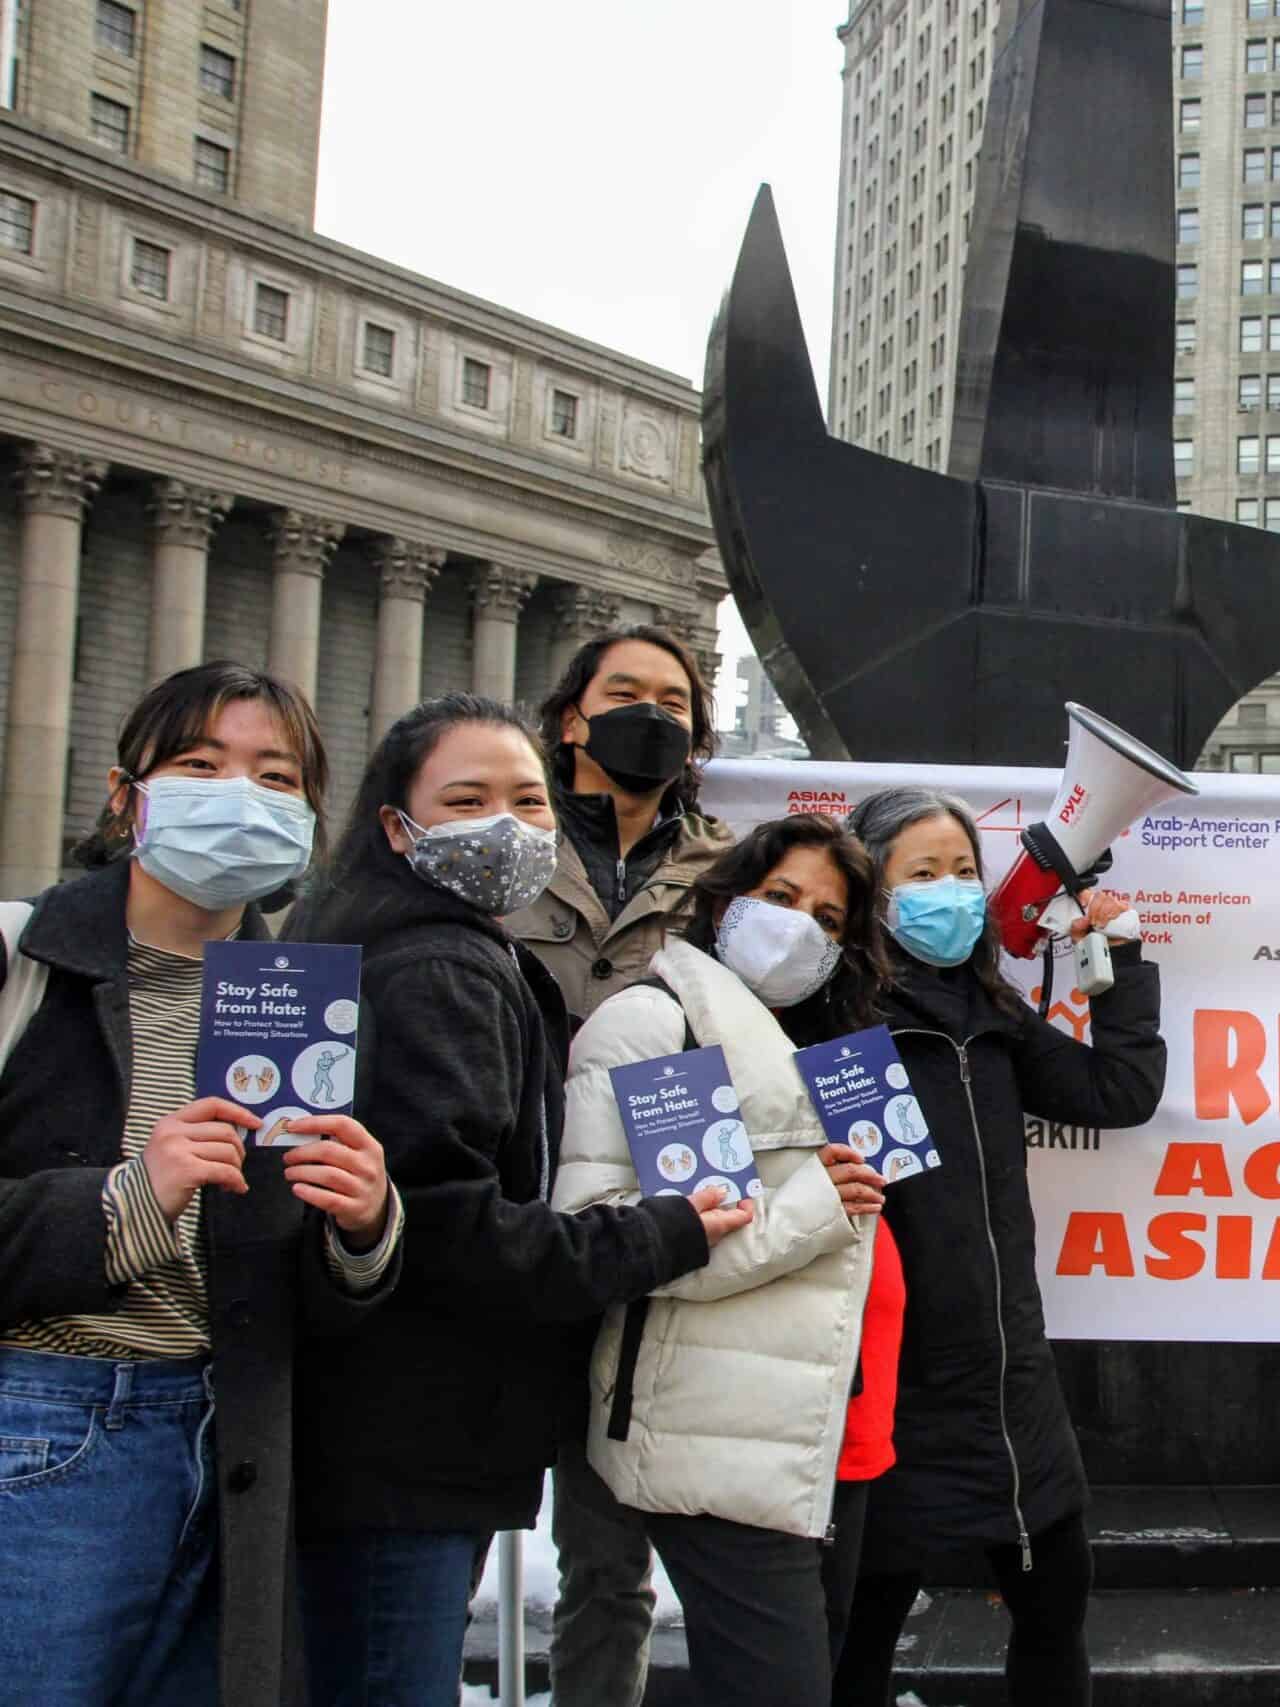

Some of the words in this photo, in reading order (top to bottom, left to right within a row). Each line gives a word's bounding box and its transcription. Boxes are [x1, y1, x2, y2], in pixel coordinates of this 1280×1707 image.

[787, 791, 846, 802] ASIAN
[1060, 783, 1085, 823] PYLE
[1142, 817, 1270, 834] Arab-American
[1142, 832, 1208, 851] Support
[1213, 835, 1270, 849] Center
[1135, 890, 1173, 904] Arab
[1177, 891, 1252, 905] American
[1138, 912, 1191, 924] ciation
[1195, 912, 1212, 925] of
[1139, 931, 1173, 944] York
[216, 981, 256, 1000] Stay
[259, 982, 298, 998] Safe
[215, 999, 257, 1014] from
[261, 1001, 307, 1016] Hate:
[815, 1074, 840, 1088] Stay
[840, 1064, 865, 1080] Safe
[628, 1093, 657, 1107] Stay
[659, 1084, 688, 1100] Safe
[819, 1086, 847, 1101] from
[846, 1076, 876, 1092] Hate:
[631, 1106, 664, 1121] from
[664, 1098, 700, 1113] Hate:
